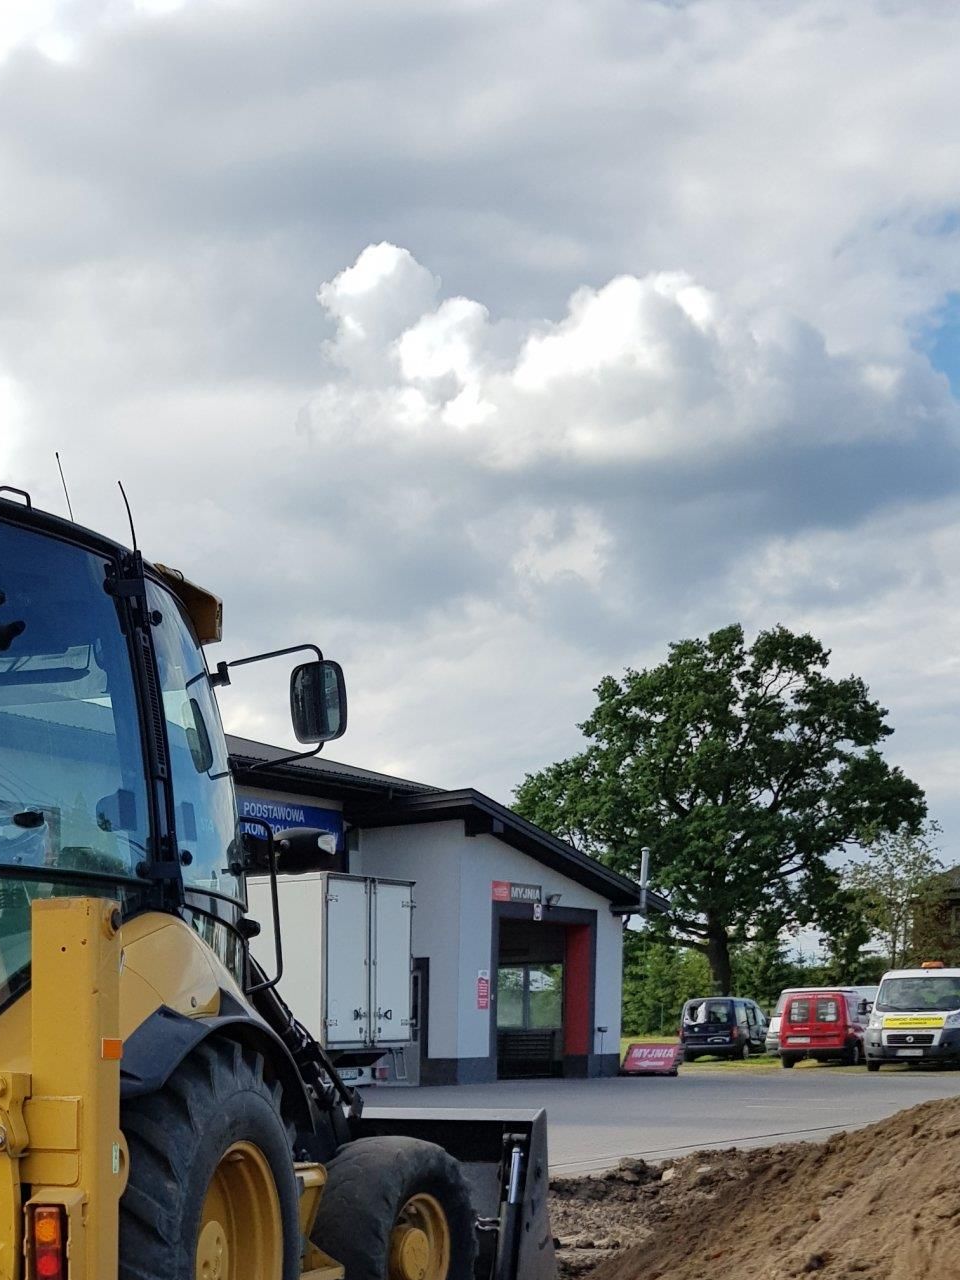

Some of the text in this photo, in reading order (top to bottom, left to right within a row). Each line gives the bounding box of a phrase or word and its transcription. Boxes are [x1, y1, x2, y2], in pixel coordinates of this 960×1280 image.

[243, 802, 305, 823] PODSTAWOWA
[511, 886, 540, 900] MYJNIA
[631, 1048, 674, 1058] MYJNIA
